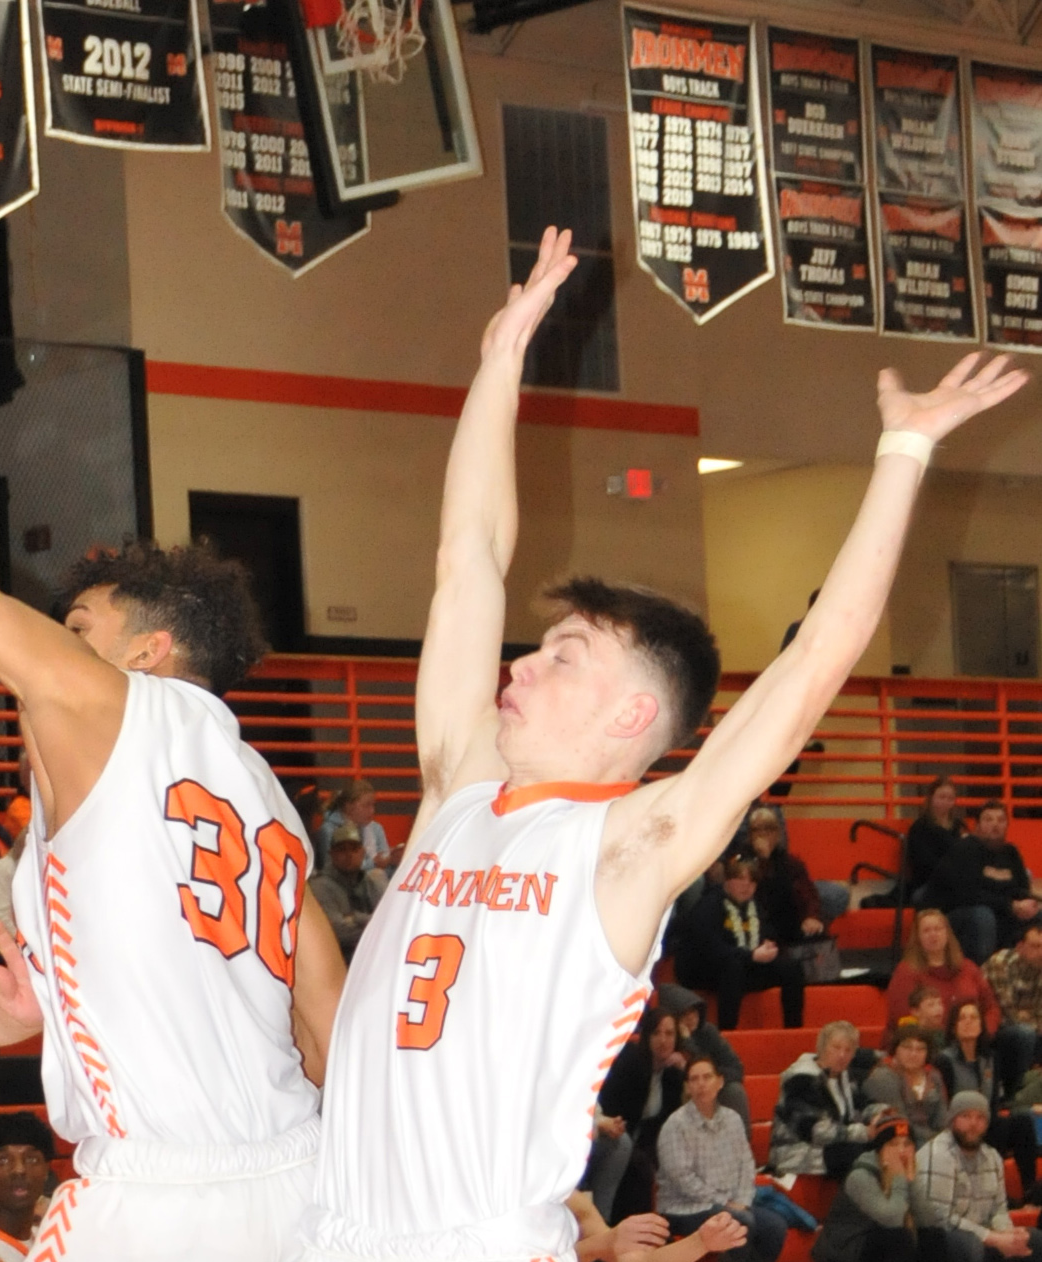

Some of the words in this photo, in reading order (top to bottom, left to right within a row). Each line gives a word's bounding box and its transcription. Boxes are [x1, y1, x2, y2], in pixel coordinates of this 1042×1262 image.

[84, 35, 152, 81] 2012
[630, 27, 746, 84] IRONMEN
[62, 73, 94, 96] STATE
[96, 78, 171, 105] SEMI-FINALIST
[255, 192, 286, 214] 2012
[164, 777, 309, 991] 30
[396, 933, 465, 1051] 3
